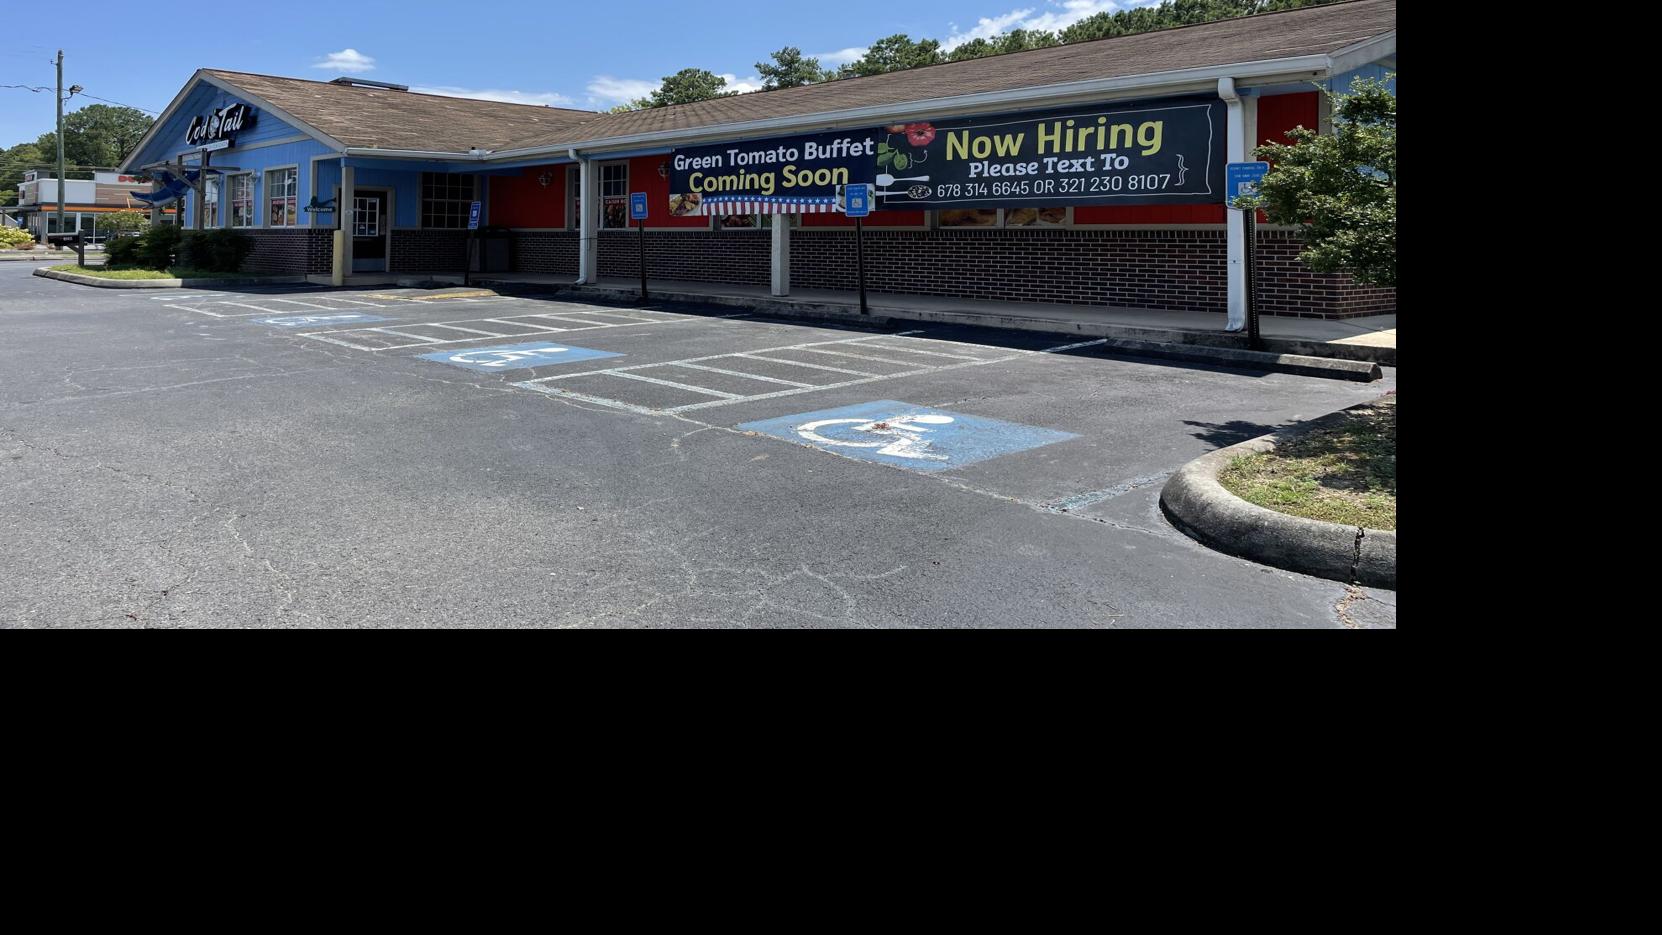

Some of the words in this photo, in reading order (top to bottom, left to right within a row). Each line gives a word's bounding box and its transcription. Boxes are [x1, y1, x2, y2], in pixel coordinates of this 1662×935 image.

[218, 102, 244, 138] Tail
[674, 154, 722, 171] Green
[727, 145, 799, 167] Tomato
[804, 137, 874, 160] Buffet
[946, 130, 1025, 161] Now
[1037, 116, 1163, 156] Hiring
[689, 169, 775, 196] Coming
[782, 164, 849, 188] Soon
[969, 160, 1039, 178] Please
[1043, 154, 1095, 174] Text
[1100, 152, 1129, 171] To
[937, 184, 961, 198] 678
[964, 182, 988, 197] 314
[992, 180, 1030, 196] 6645
[1034, 179, 1054, 194] OR
[1058, 177, 1085, 193] 321
[1089, 176, 1122, 192] 230
[1127, 173, 1171, 191] 8107
